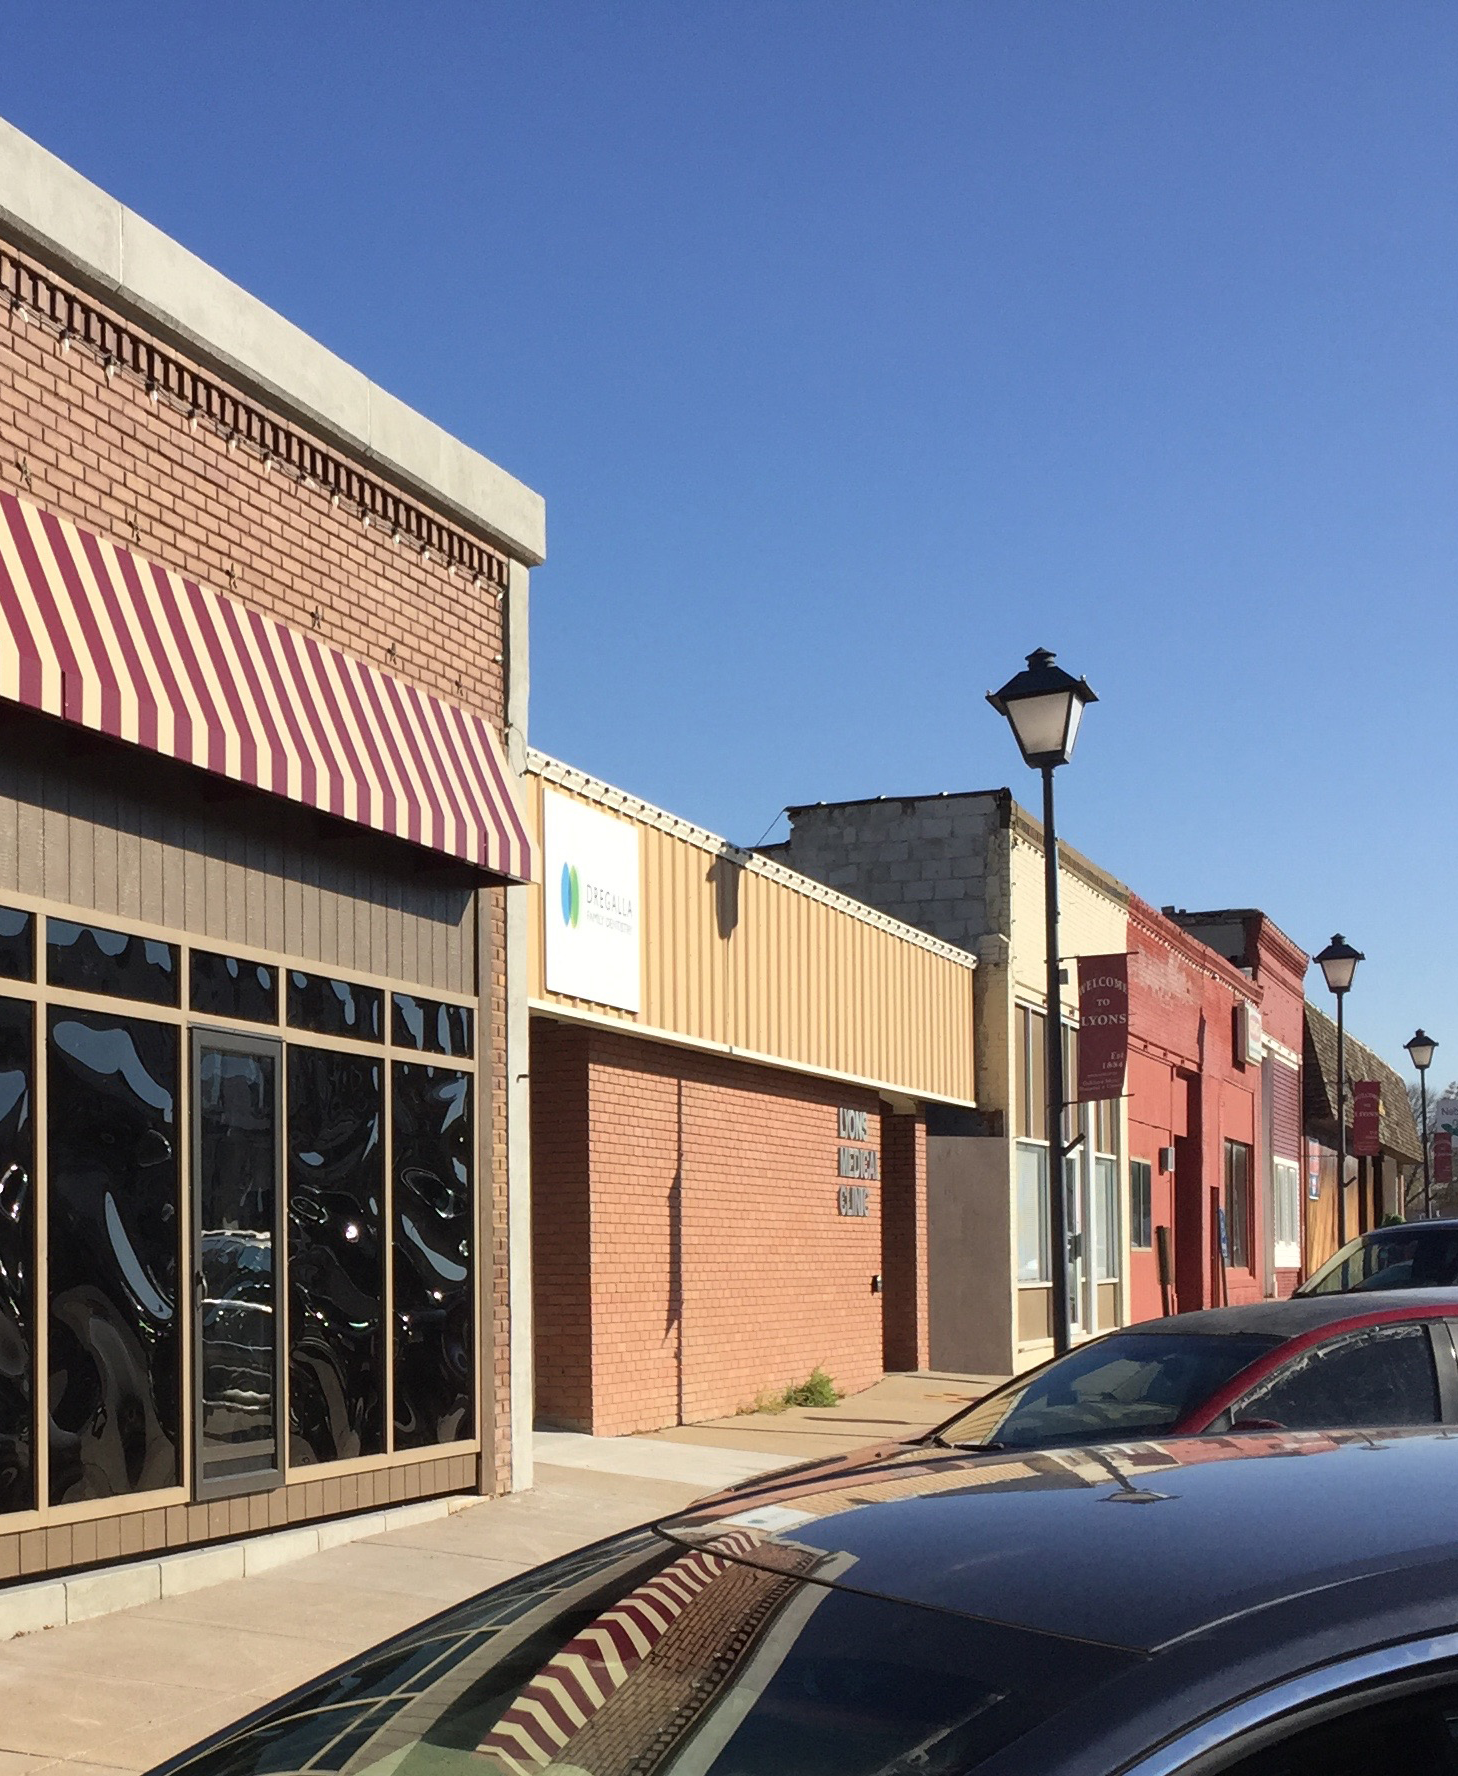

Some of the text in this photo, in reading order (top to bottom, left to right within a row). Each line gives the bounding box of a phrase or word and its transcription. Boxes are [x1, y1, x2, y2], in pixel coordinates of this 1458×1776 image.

[1079, 976, 1128, 997] WELCOME
[1096, 998, 1111, 1007] TO
[1081, 1013, 1127, 1028] LYONS
[839, 1107, 868, 1142] LYONS
[839, 1184, 870, 1217] CLINIC
